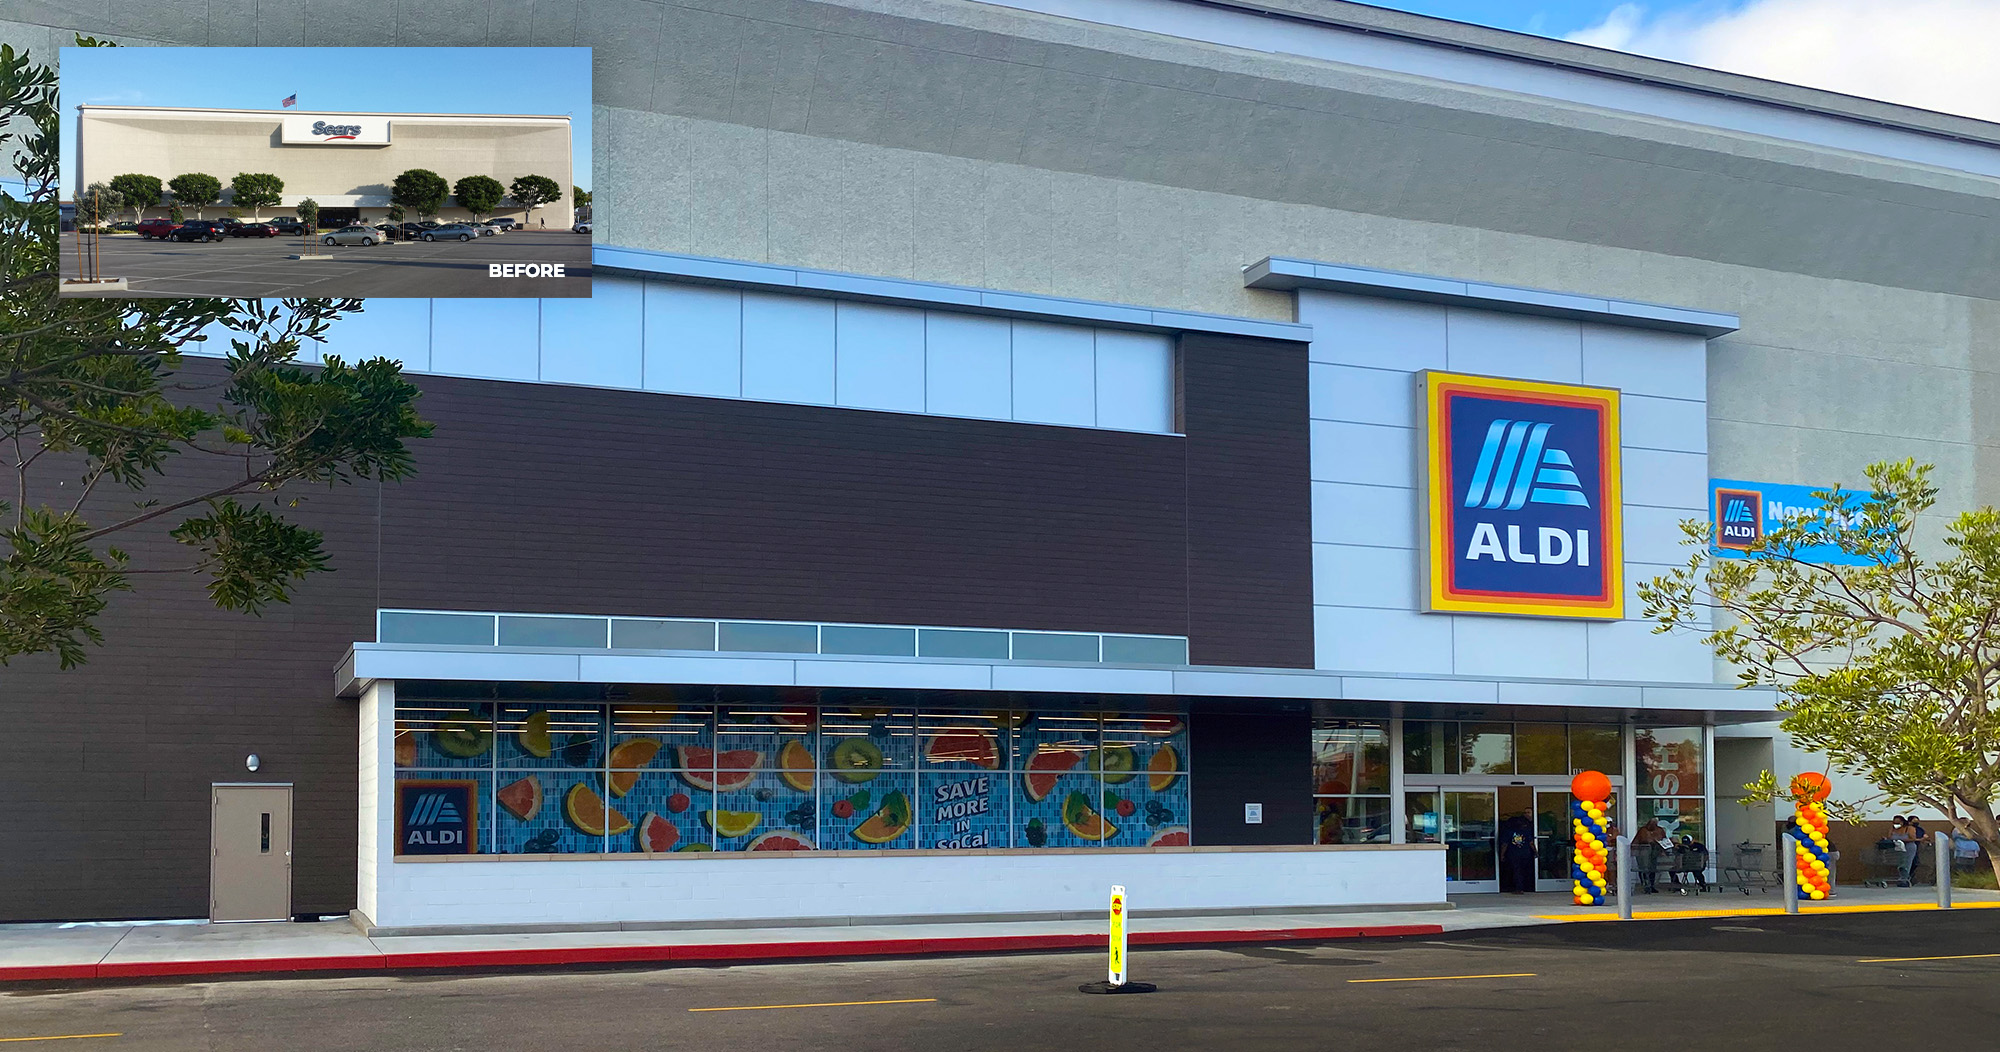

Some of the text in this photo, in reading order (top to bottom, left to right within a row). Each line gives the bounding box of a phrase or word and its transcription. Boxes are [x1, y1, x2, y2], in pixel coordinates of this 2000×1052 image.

[312, 120, 362, 136] Sears
[1724, 525, 1755, 538] ALDI
[1466, 522, 1589, 567] ALDI
[936, 776, 989, 803] SAVE
[936, 797, 989, 822] MORE
[955, 819, 970, 832] IN
[407, 830, 463, 845] ALDI
